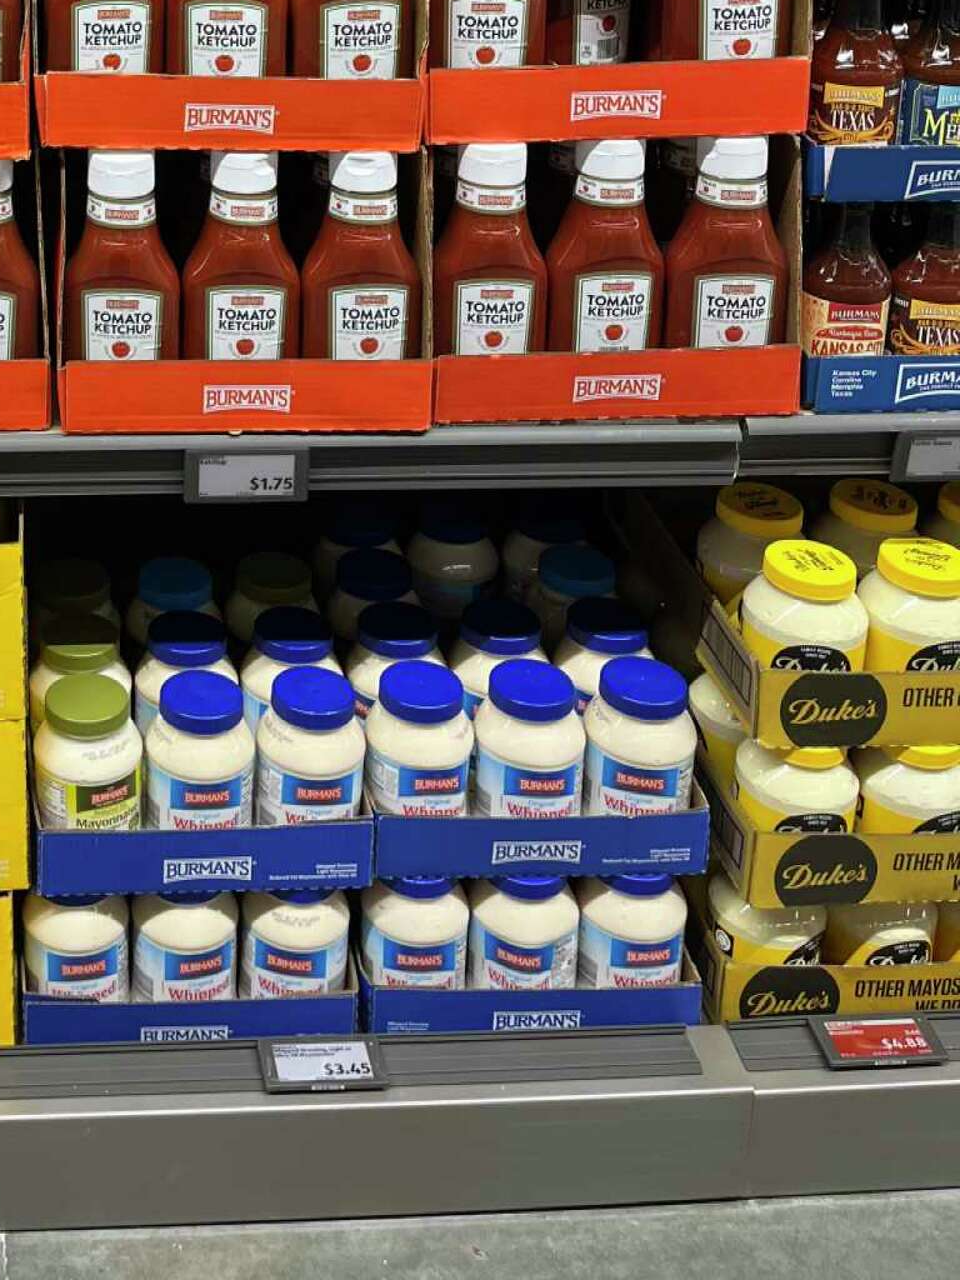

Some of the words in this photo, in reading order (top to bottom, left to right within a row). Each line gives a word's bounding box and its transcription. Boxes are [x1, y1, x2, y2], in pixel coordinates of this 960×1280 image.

[713, 6, 772, 20] TOMATO
[84, 22, 142, 36] TOMATO
[196, 23, 257, 36] TOMATO
[333, 22, 392, 36] TOMATO
[457, 16, 519, 29] TOMATO
[714, 18, 770, 31] KETCHUP
[85, 34, 141, 46] KETCHUP
[197, 34, 256, 48] KETCHUP
[335, 34, 391, 48] KETCHUP
[458, 28, 518, 40] KETCHUP
[574, 95, 659, 116] BURMAN'S
[187, 109, 272, 129] BURMAN'S
[831, 111, 875, 131] TEXAS
[466, 301, 525, 314] TOMATO
[587, 294, 645, 307] TOMATO
[707, 296, 766, 309] TOMATO
[93, 310, 152, 324] TOMATO
[217, 307, 276, 321] TOMATO
[341, 306, 400, 320] TOMATO
[467, 312, 524, 324] KETCHUP
[588, 305, 644, 318] KETCHUP
[708, 308, 765, 319] KETCHUP
[94, 322, 152, 335] KETCHUP
[218, 319, 276, 331] KETCHUP
[342, 319, 399, 331] KETCHUP
[577, 379, 658, 397] BURMAN'S
[206, 389, 288, 409] BURMAN'S
[250, 477, 292, 491] $1.75
[903, 687, 953, 708] OTHER
[790, 697, 877, 725] Duke's
[415, 777, 459, 791] BURMAN'S
[520, 778, 564, 791] BURMAN'S
[185, 791, 230, 803] BURMAN'S
[296, 788, 342, 799] BURMAN'S
[495, 844, 580, 862] BURMAN'S
[893, 853, 942, 871] OTHER
[167, 861, 250, 880] BURMAN'S
[783, 863, 869, 890] Duke's
[854, 979, 903, 998] OTHER
[748, 990, 830, 1017] Duke's
[497, 1013, 579, 1030] BURMAN'S
[881, 1037, 927, 1049] $4.88
[325, 1062, 371, 1075] $3.45
